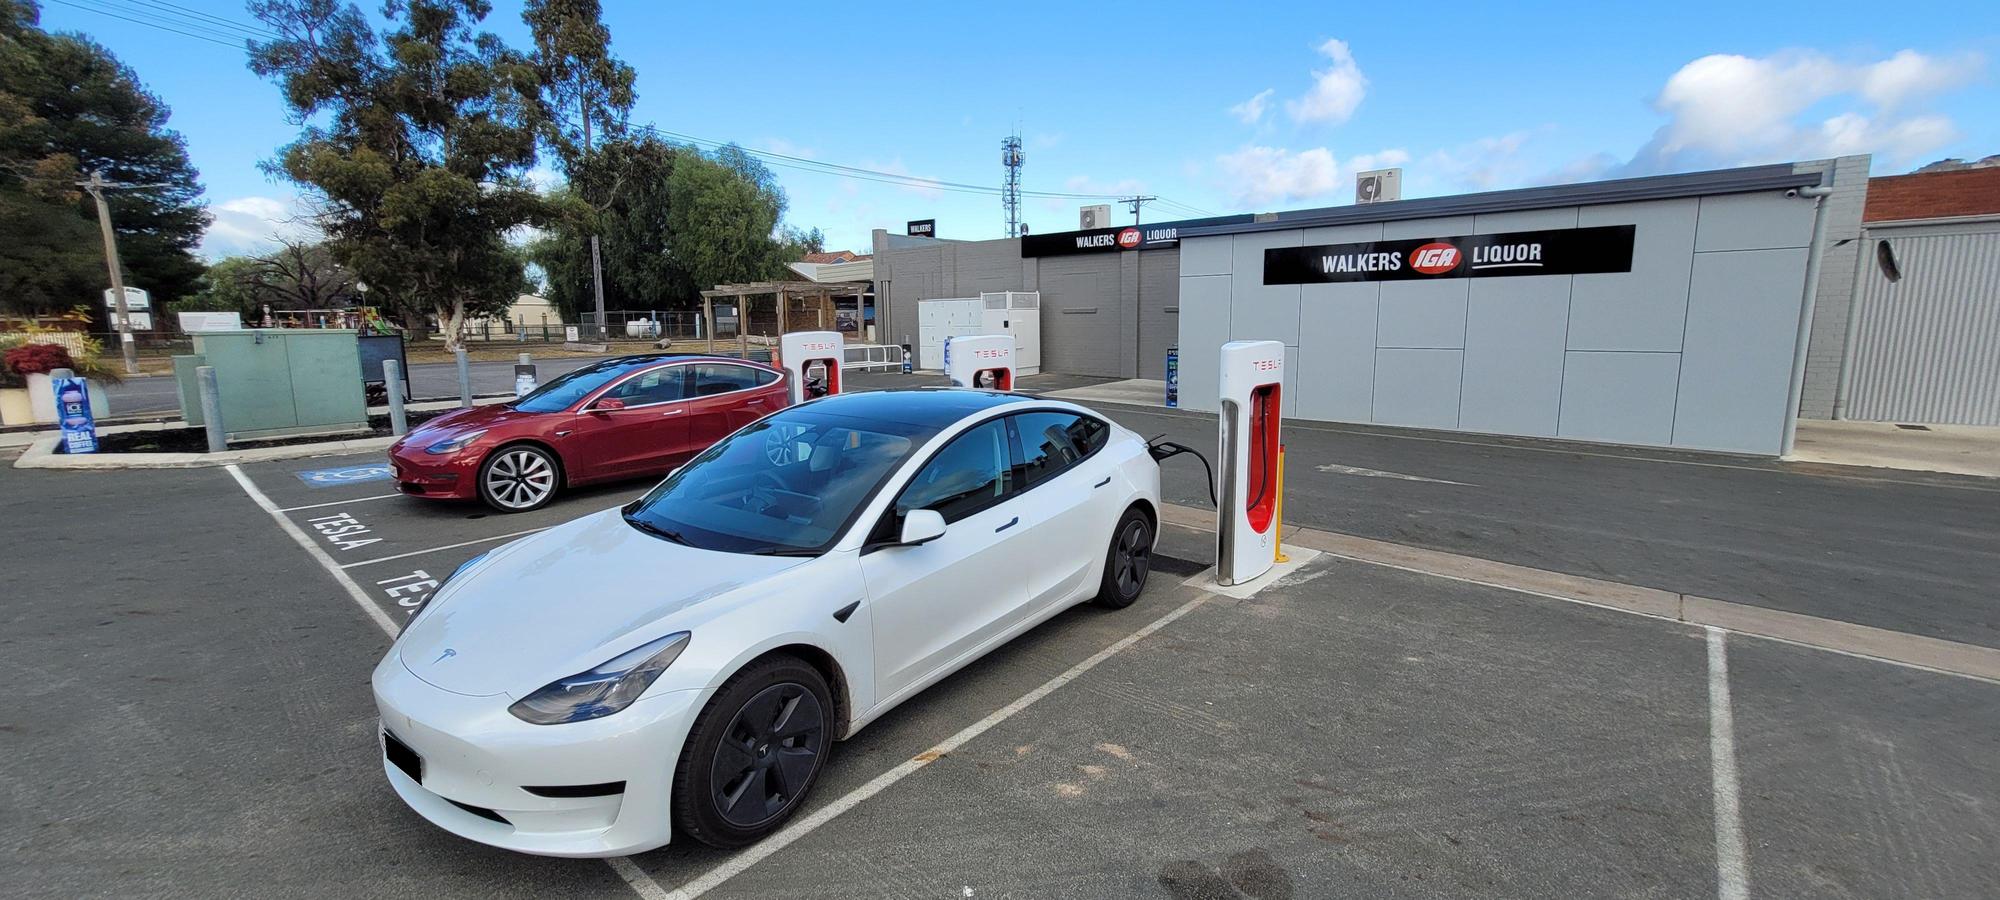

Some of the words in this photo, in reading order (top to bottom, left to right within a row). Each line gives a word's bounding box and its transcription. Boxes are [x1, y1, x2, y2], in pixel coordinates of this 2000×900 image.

[1076, 233, 1115, 248] WALKERS
[1120, 231, 1140, 244] IGA
[1146, 228, 1177, 241] LIQUOR
[1322, 252, 1401, 273] WALKERS
[1412, 246, 1454, 268] IGA
[1472, 244, 1542, 263] LIQUOR
[802, 343, 836, 351] TESLA
[975, 349, 1009, 359] TESLA
[67, 431, 92, 441] REAL
[307, 512, 383, 551] TESLA
[376, 569, 439, 616] TES
